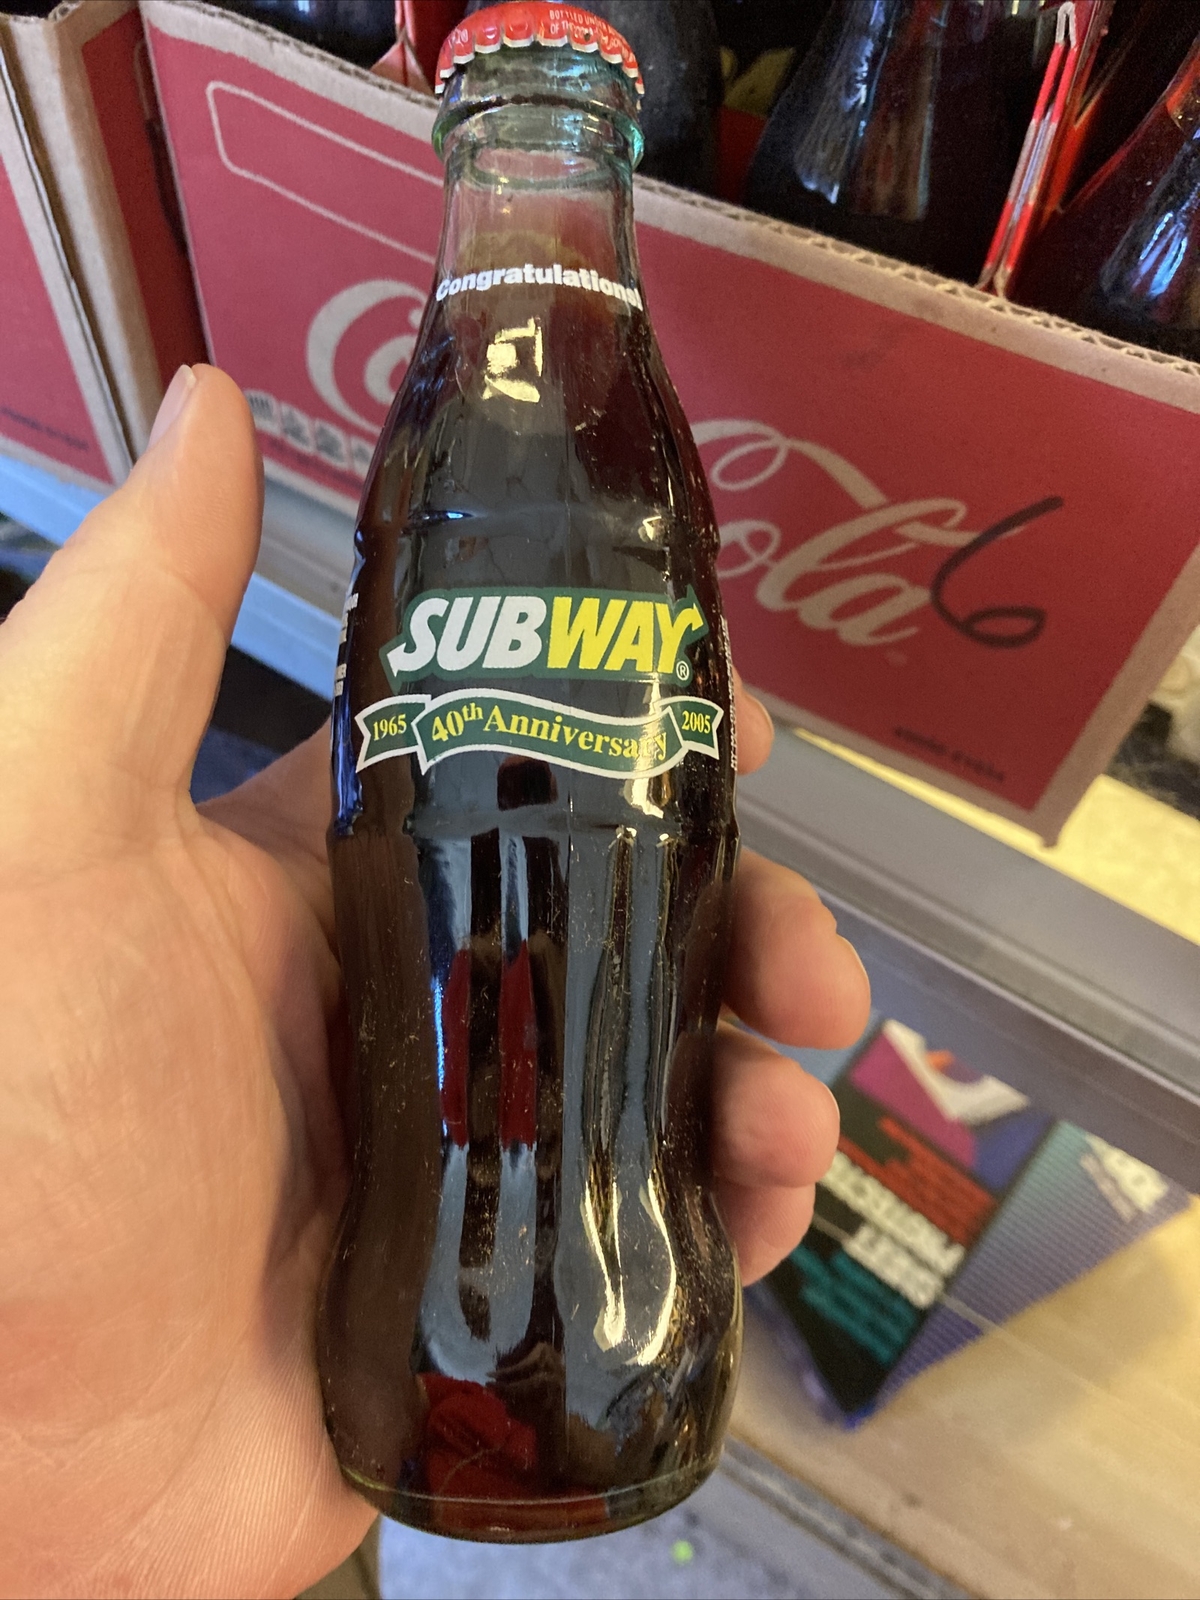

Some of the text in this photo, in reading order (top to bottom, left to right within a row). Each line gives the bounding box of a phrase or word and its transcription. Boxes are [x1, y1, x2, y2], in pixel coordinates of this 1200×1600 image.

[549, 9, 584, 24] BOTTLED
[550, 23, 559, 34] OF
[930, 496, 1064, 649] 6
[387, 595, 704, 678] SUBWAY
[373, 702, 711, 760] 1965 40th Anniversary 2005
